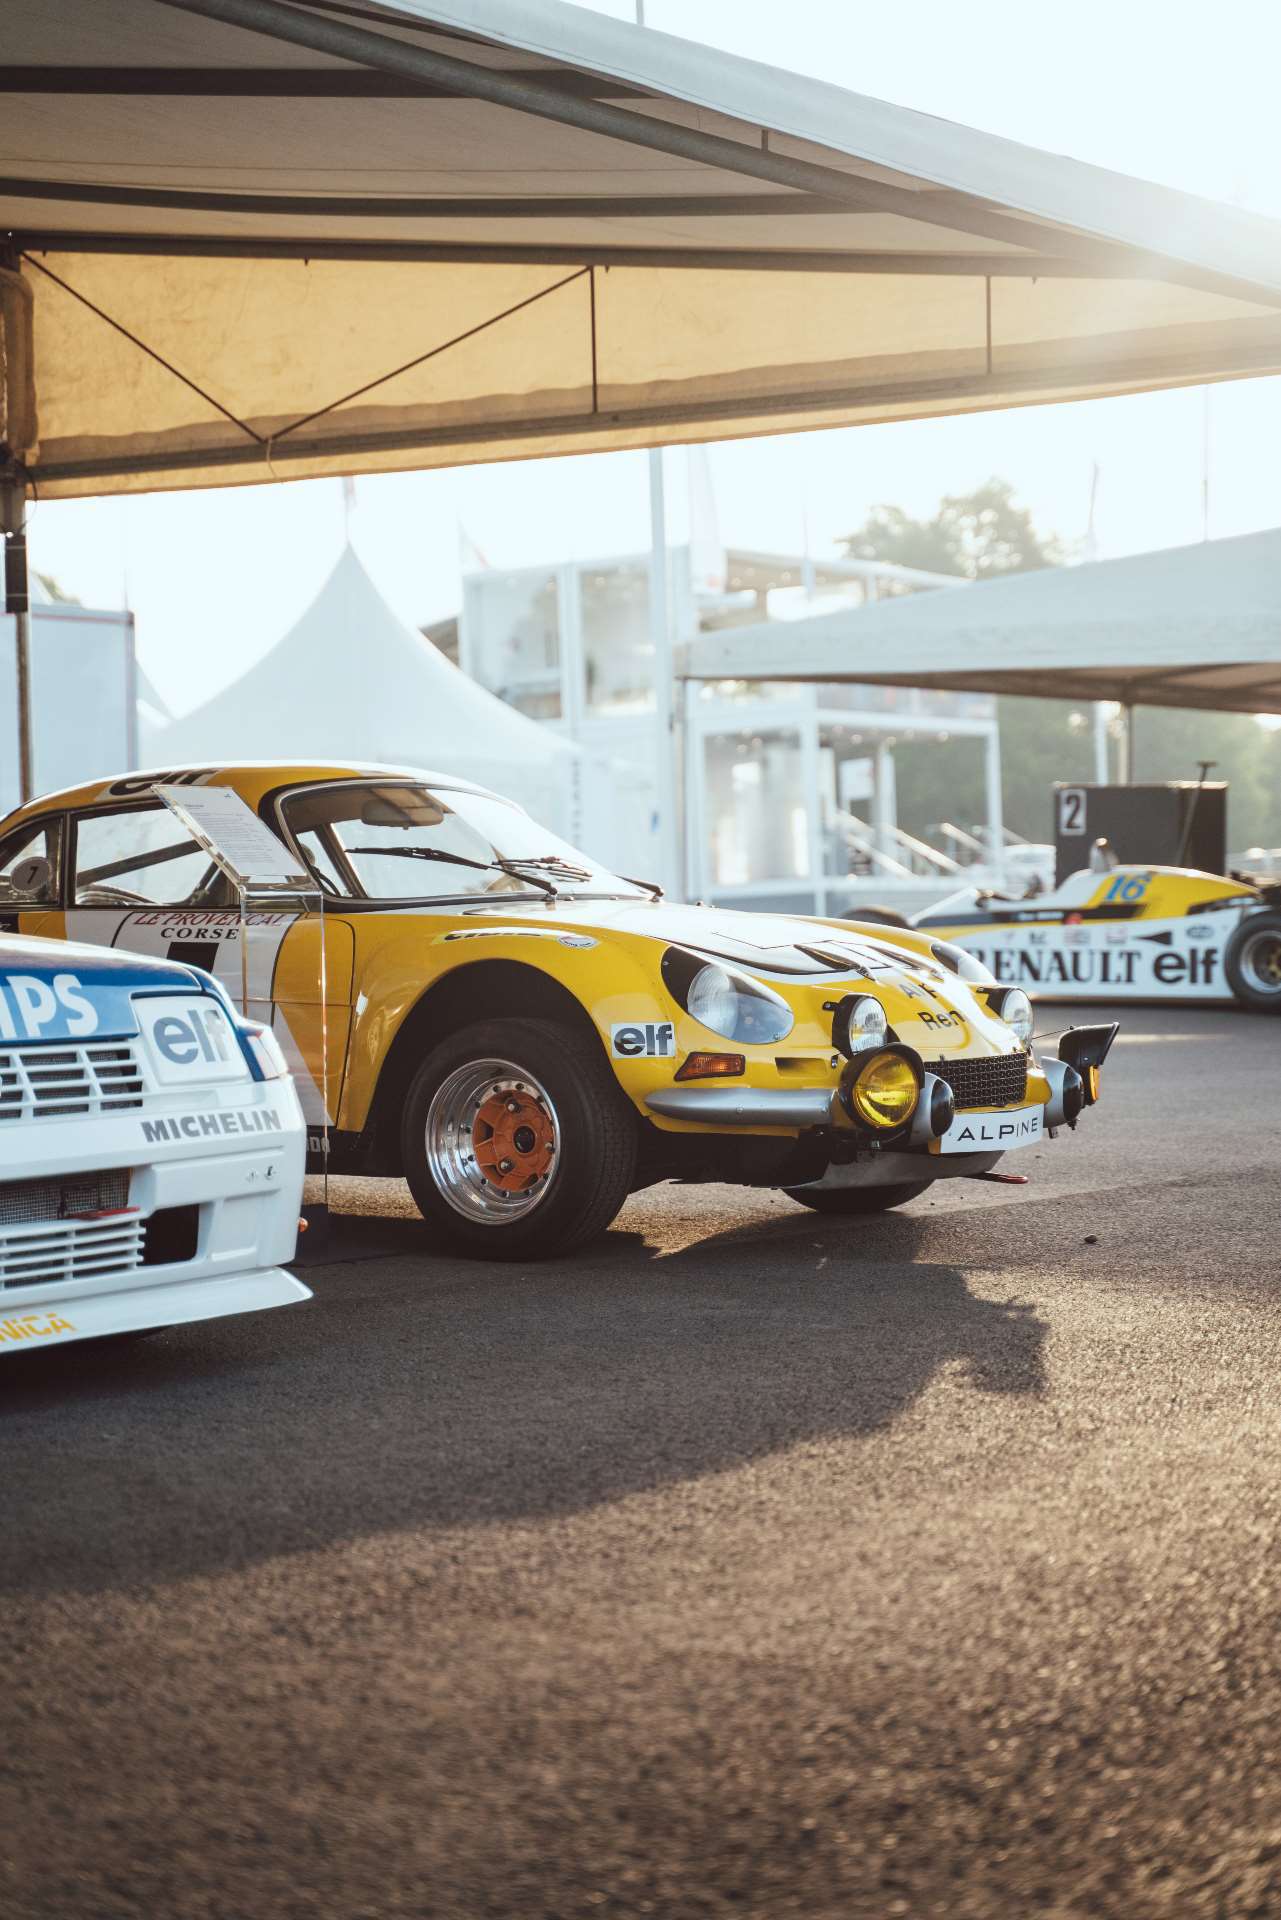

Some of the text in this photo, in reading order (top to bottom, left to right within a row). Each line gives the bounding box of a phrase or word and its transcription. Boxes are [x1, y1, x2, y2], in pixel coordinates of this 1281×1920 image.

[1063, 793, 1081, 831] 2
[1104, 874, 1150, 901] 16
[133, 912, 161, 926] LE
[160, 927, 240, 940] CORSE
[1153, 948, 1218, 985] elf
[152, 1009, 228, 1064] elf
[613, 1023, 673, 1056] elf
[140, 1109, 282, 1143] MICHELIN
[957, 1117, 1039, 1142] ALPINE
